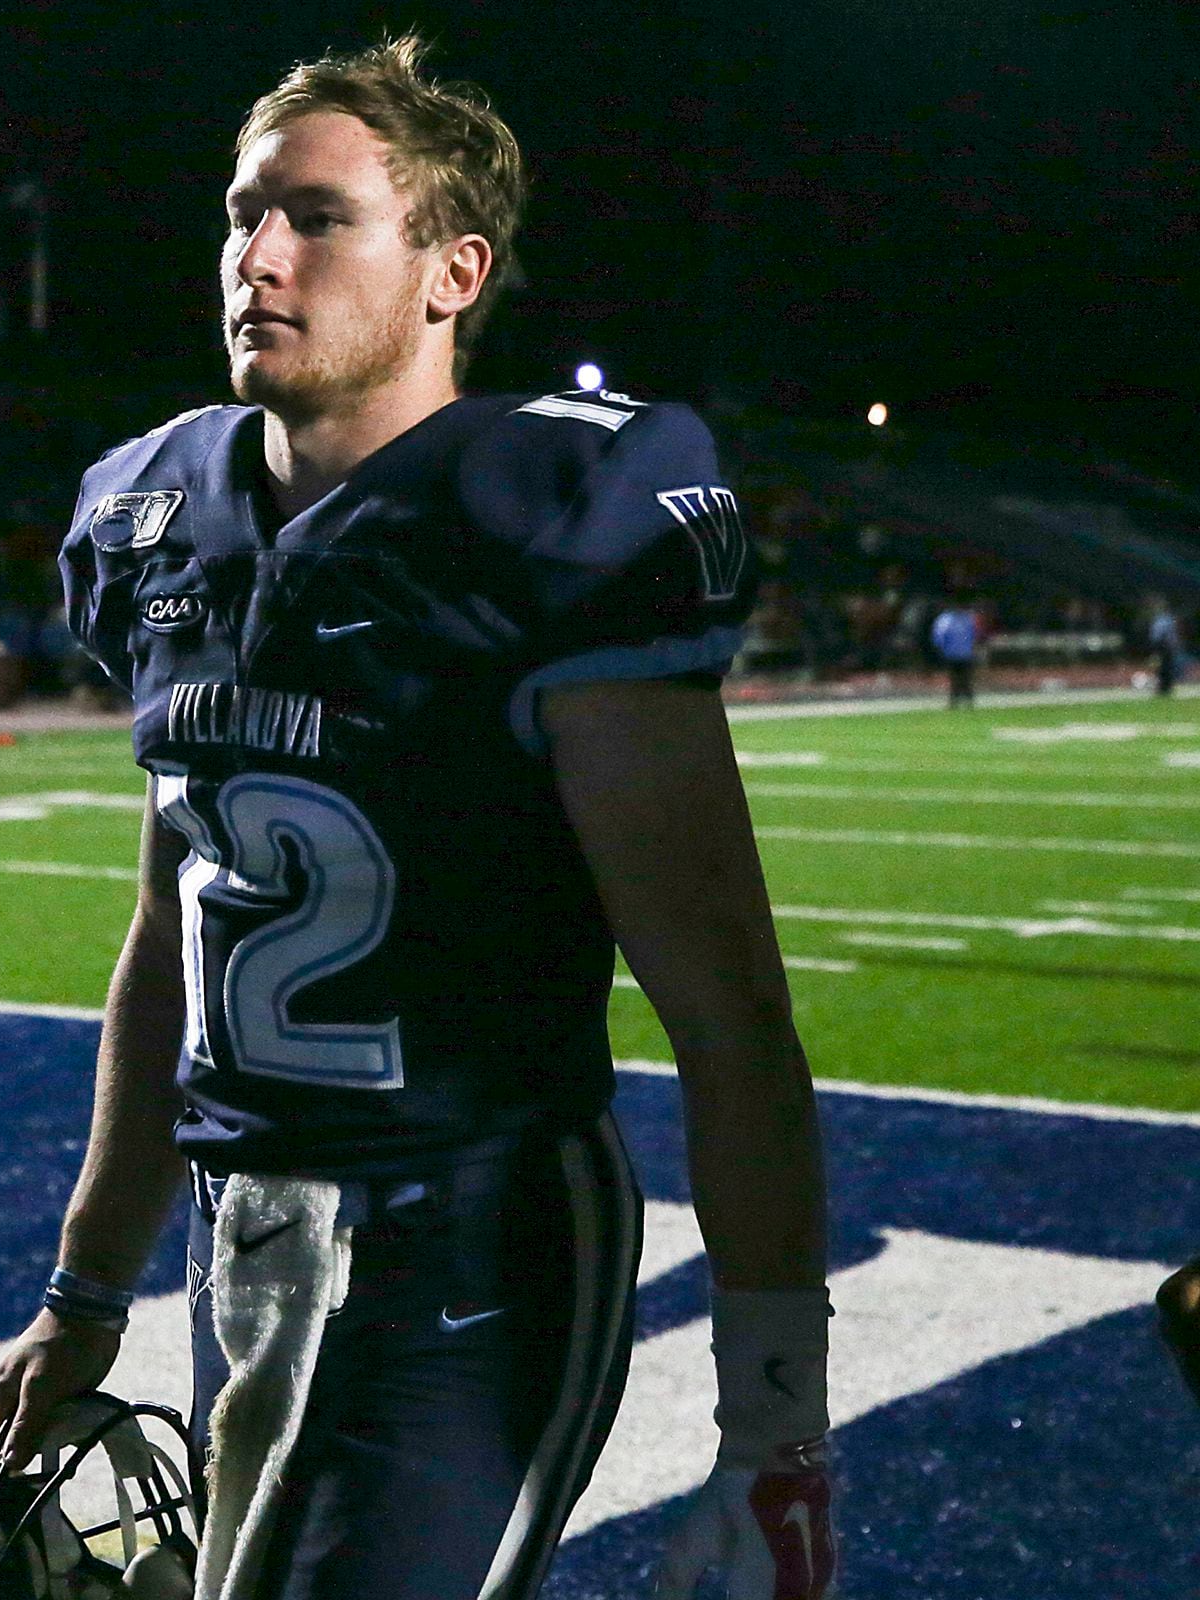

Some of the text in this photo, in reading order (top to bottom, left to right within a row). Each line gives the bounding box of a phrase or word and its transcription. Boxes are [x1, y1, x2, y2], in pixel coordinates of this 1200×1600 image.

[148, 598, 192, 620] CAA
[168, 683, 321, 757] VILLANOVA
[156, 772, 404, 1088] 12
